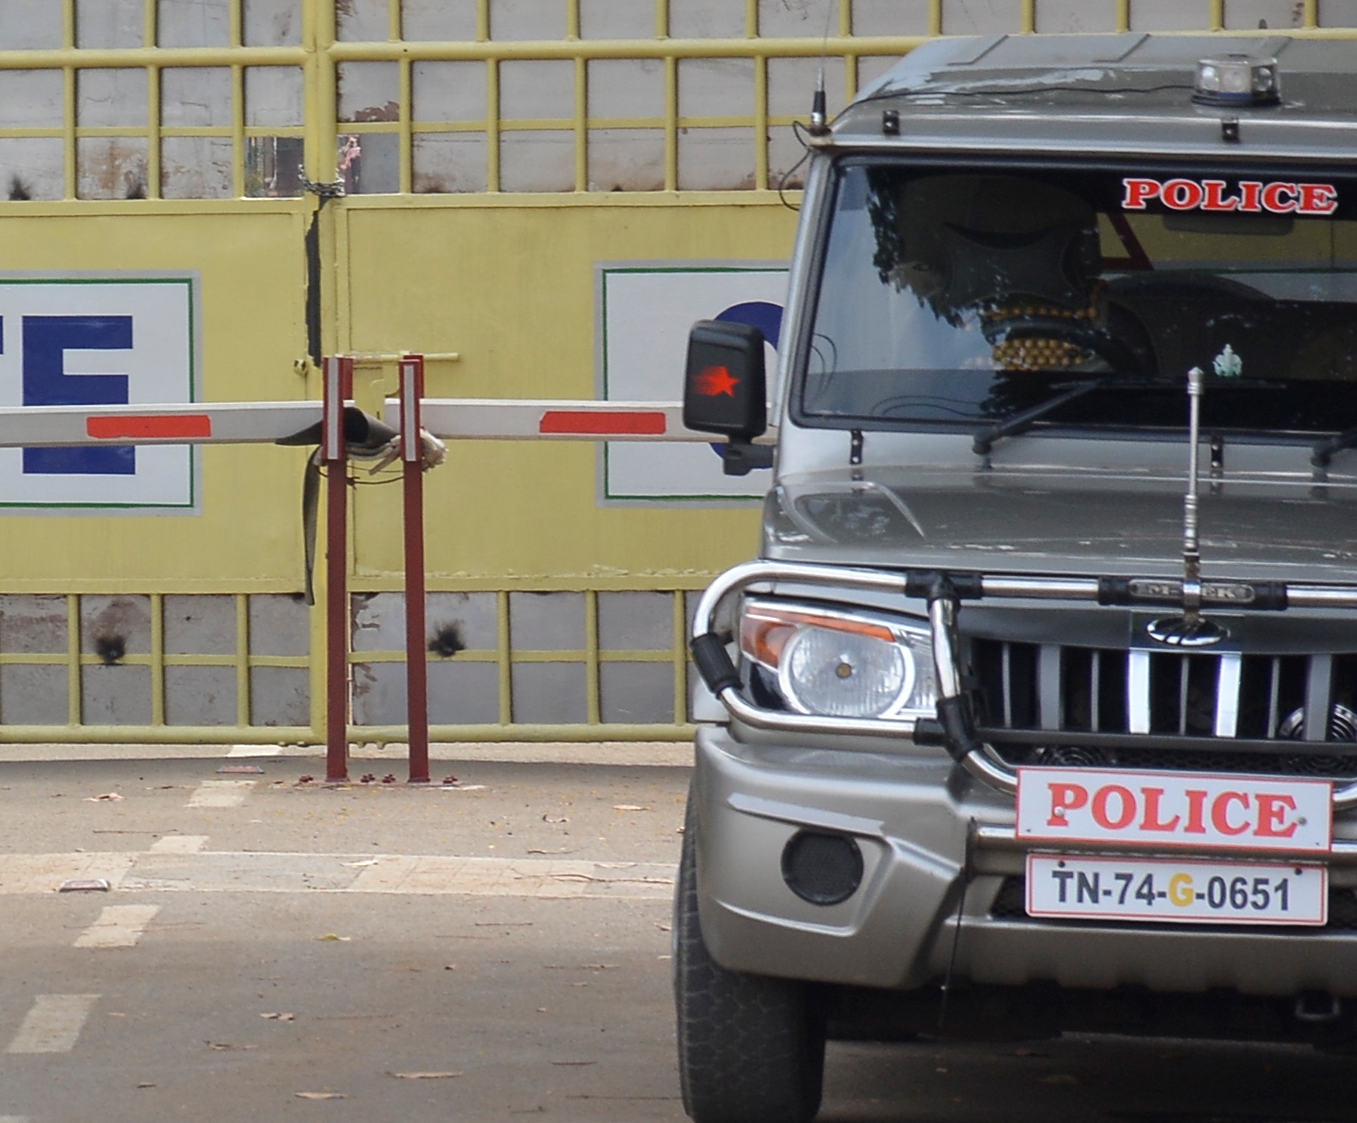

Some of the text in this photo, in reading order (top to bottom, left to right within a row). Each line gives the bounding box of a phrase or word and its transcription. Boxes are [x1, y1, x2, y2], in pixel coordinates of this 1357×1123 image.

[1122, 178, 1338, 215] POLICE
[1046, 782, 1298, 838] POLICE
[1051, 870, 1290, 912] TN-74-G-0651
